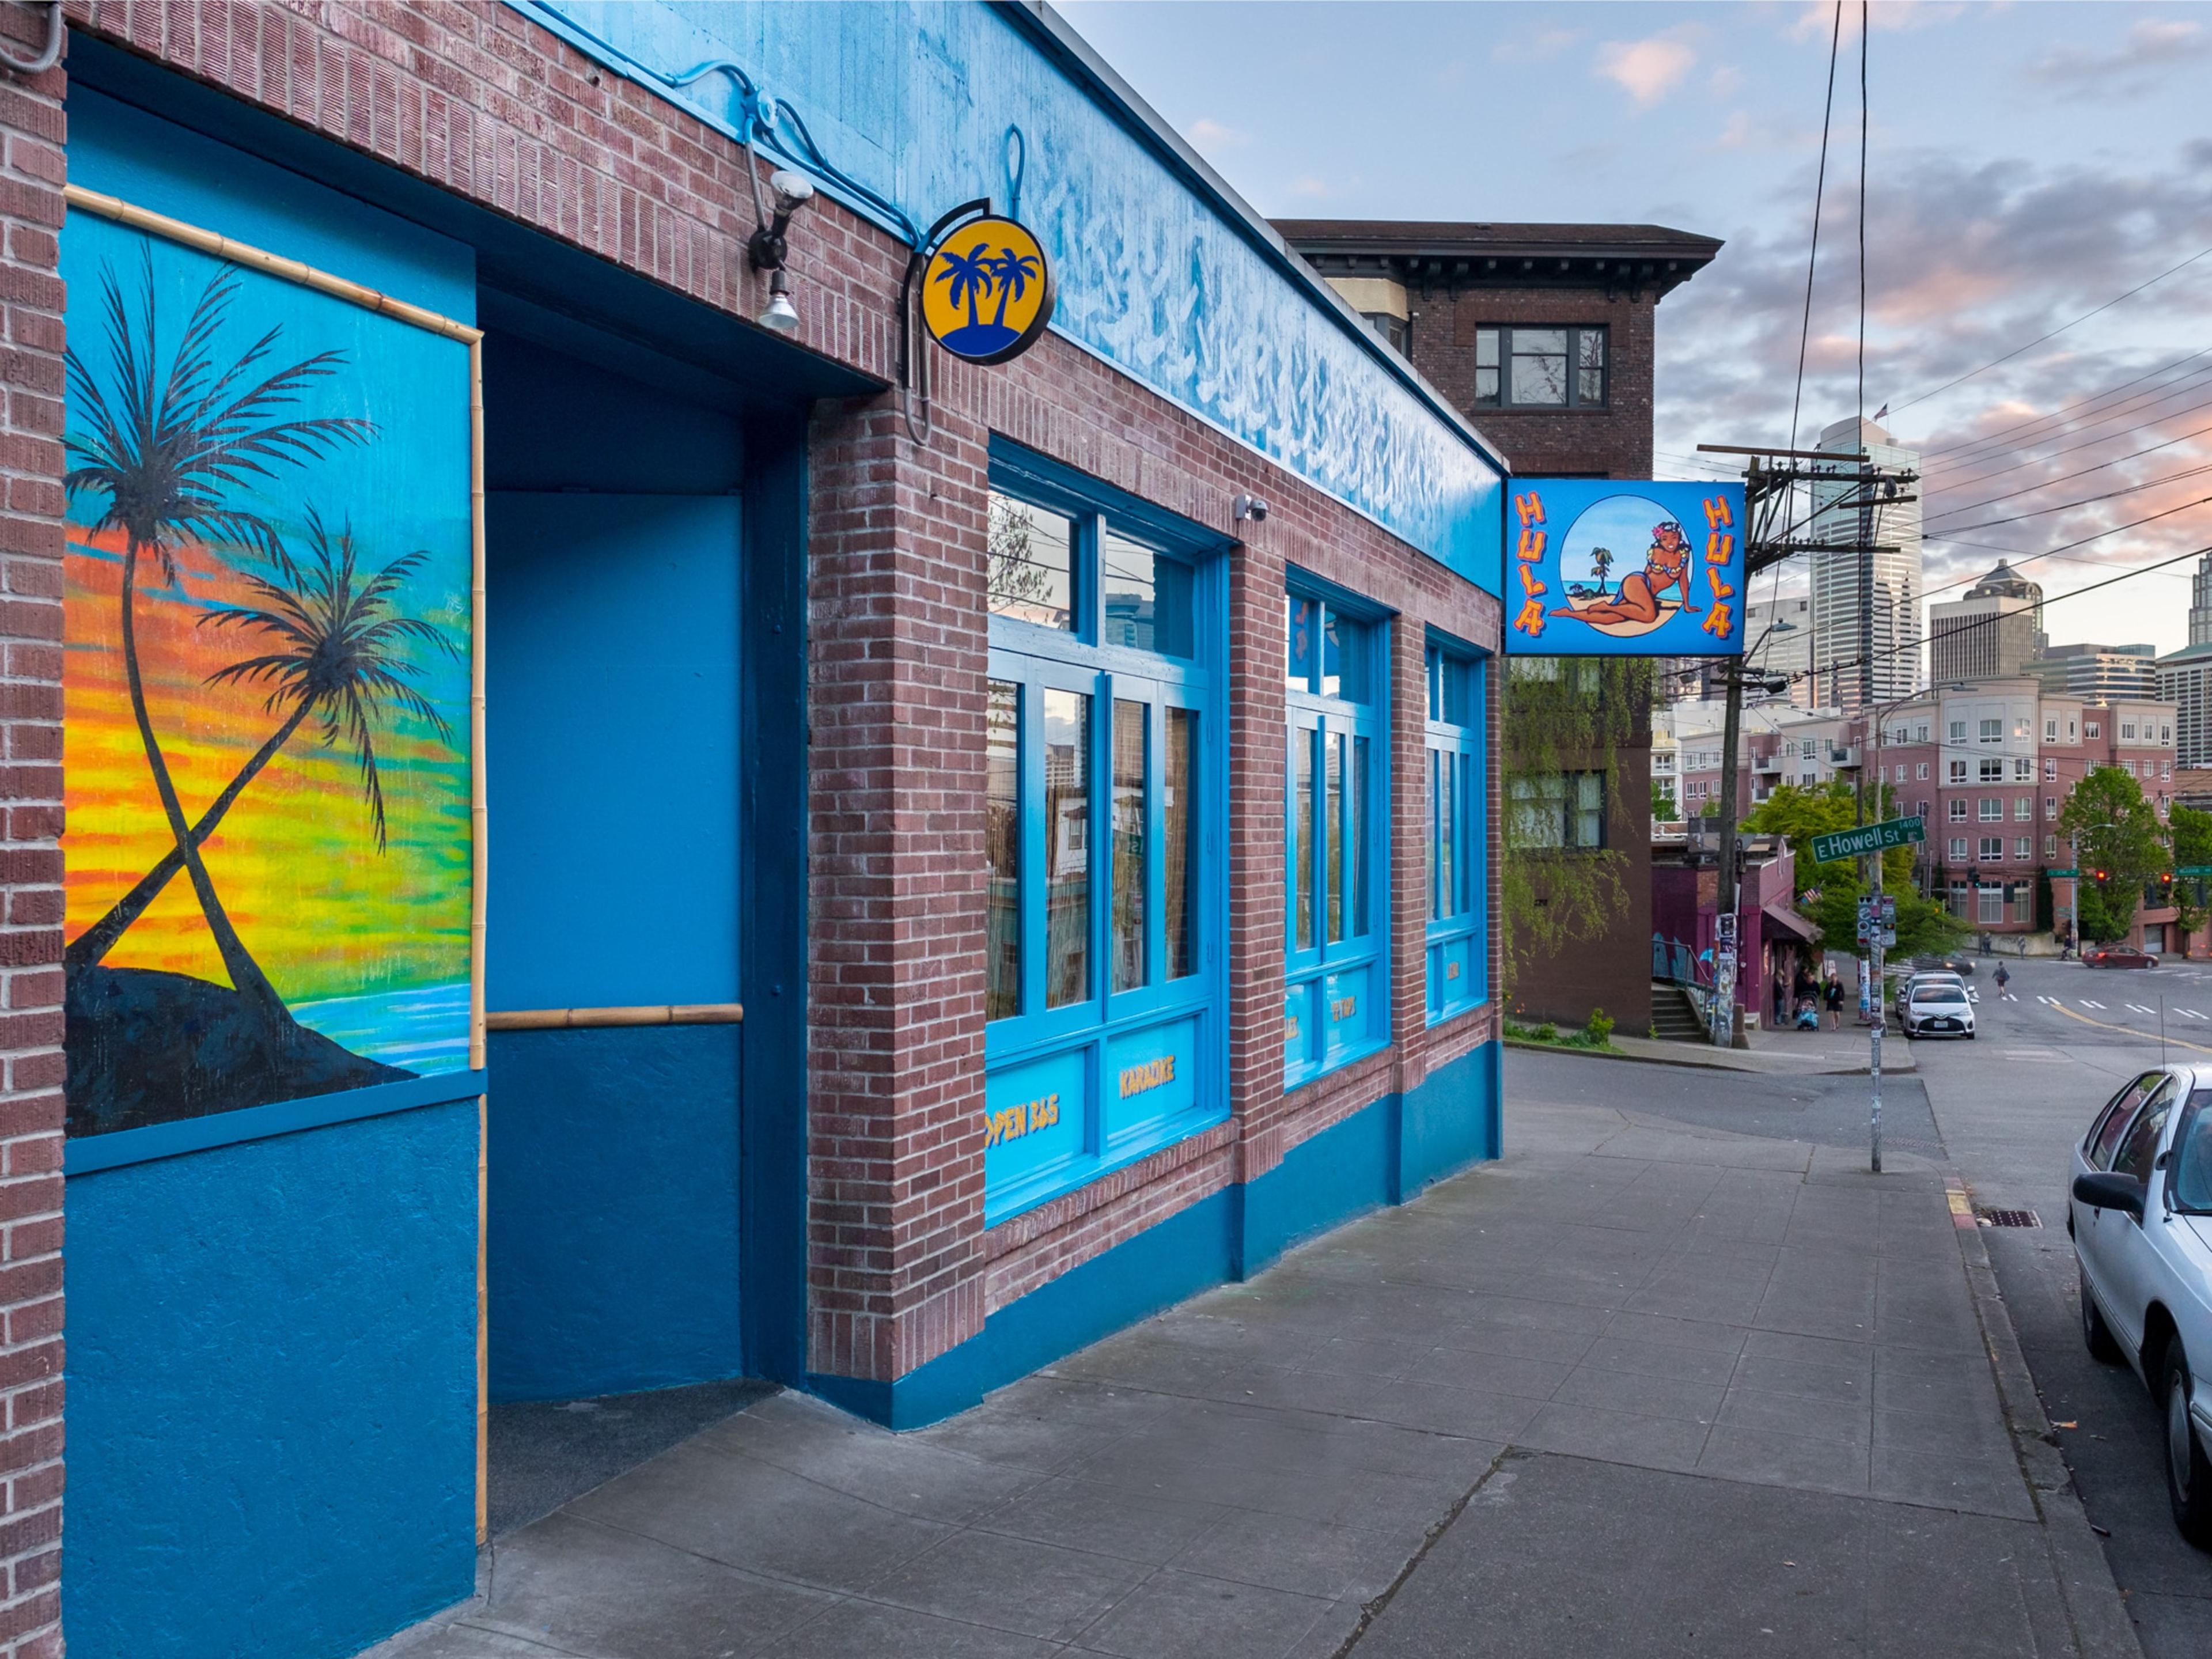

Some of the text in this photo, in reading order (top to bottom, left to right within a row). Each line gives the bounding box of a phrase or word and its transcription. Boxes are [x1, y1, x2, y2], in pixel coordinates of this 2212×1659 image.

[1514, 491, 1547, 637] HULA
[1702, 494, 1734, 638] HULA
[1817, 827, 1899, 858] E Howell St
[1899, 818, 1921, 830] 1400
[1120, 1054, 1175, 1100] KARAOKE
[1030, 1093, 1059, 1133] 365
